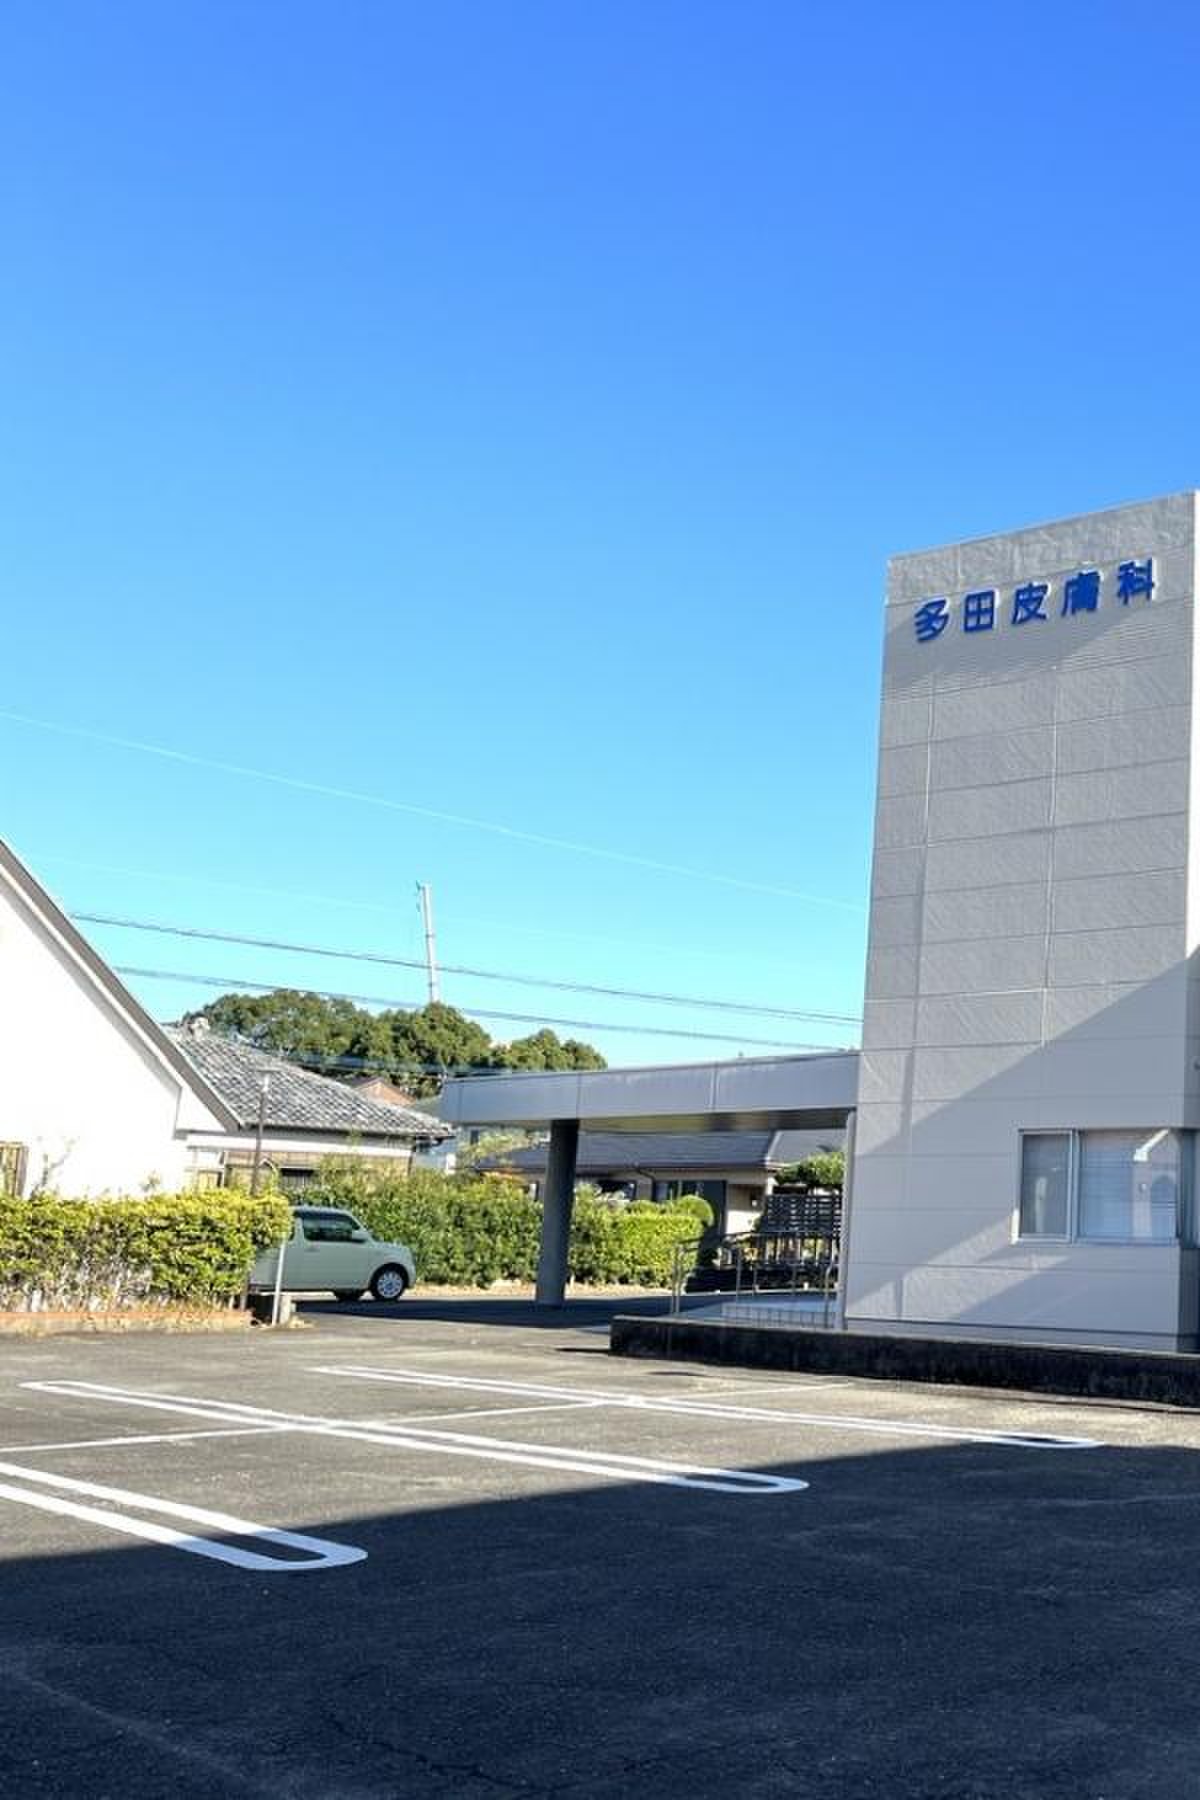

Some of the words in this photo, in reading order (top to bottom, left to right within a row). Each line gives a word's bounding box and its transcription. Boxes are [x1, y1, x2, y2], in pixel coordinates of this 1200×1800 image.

[914, 558, 1156, 642] 多田皮膚科
